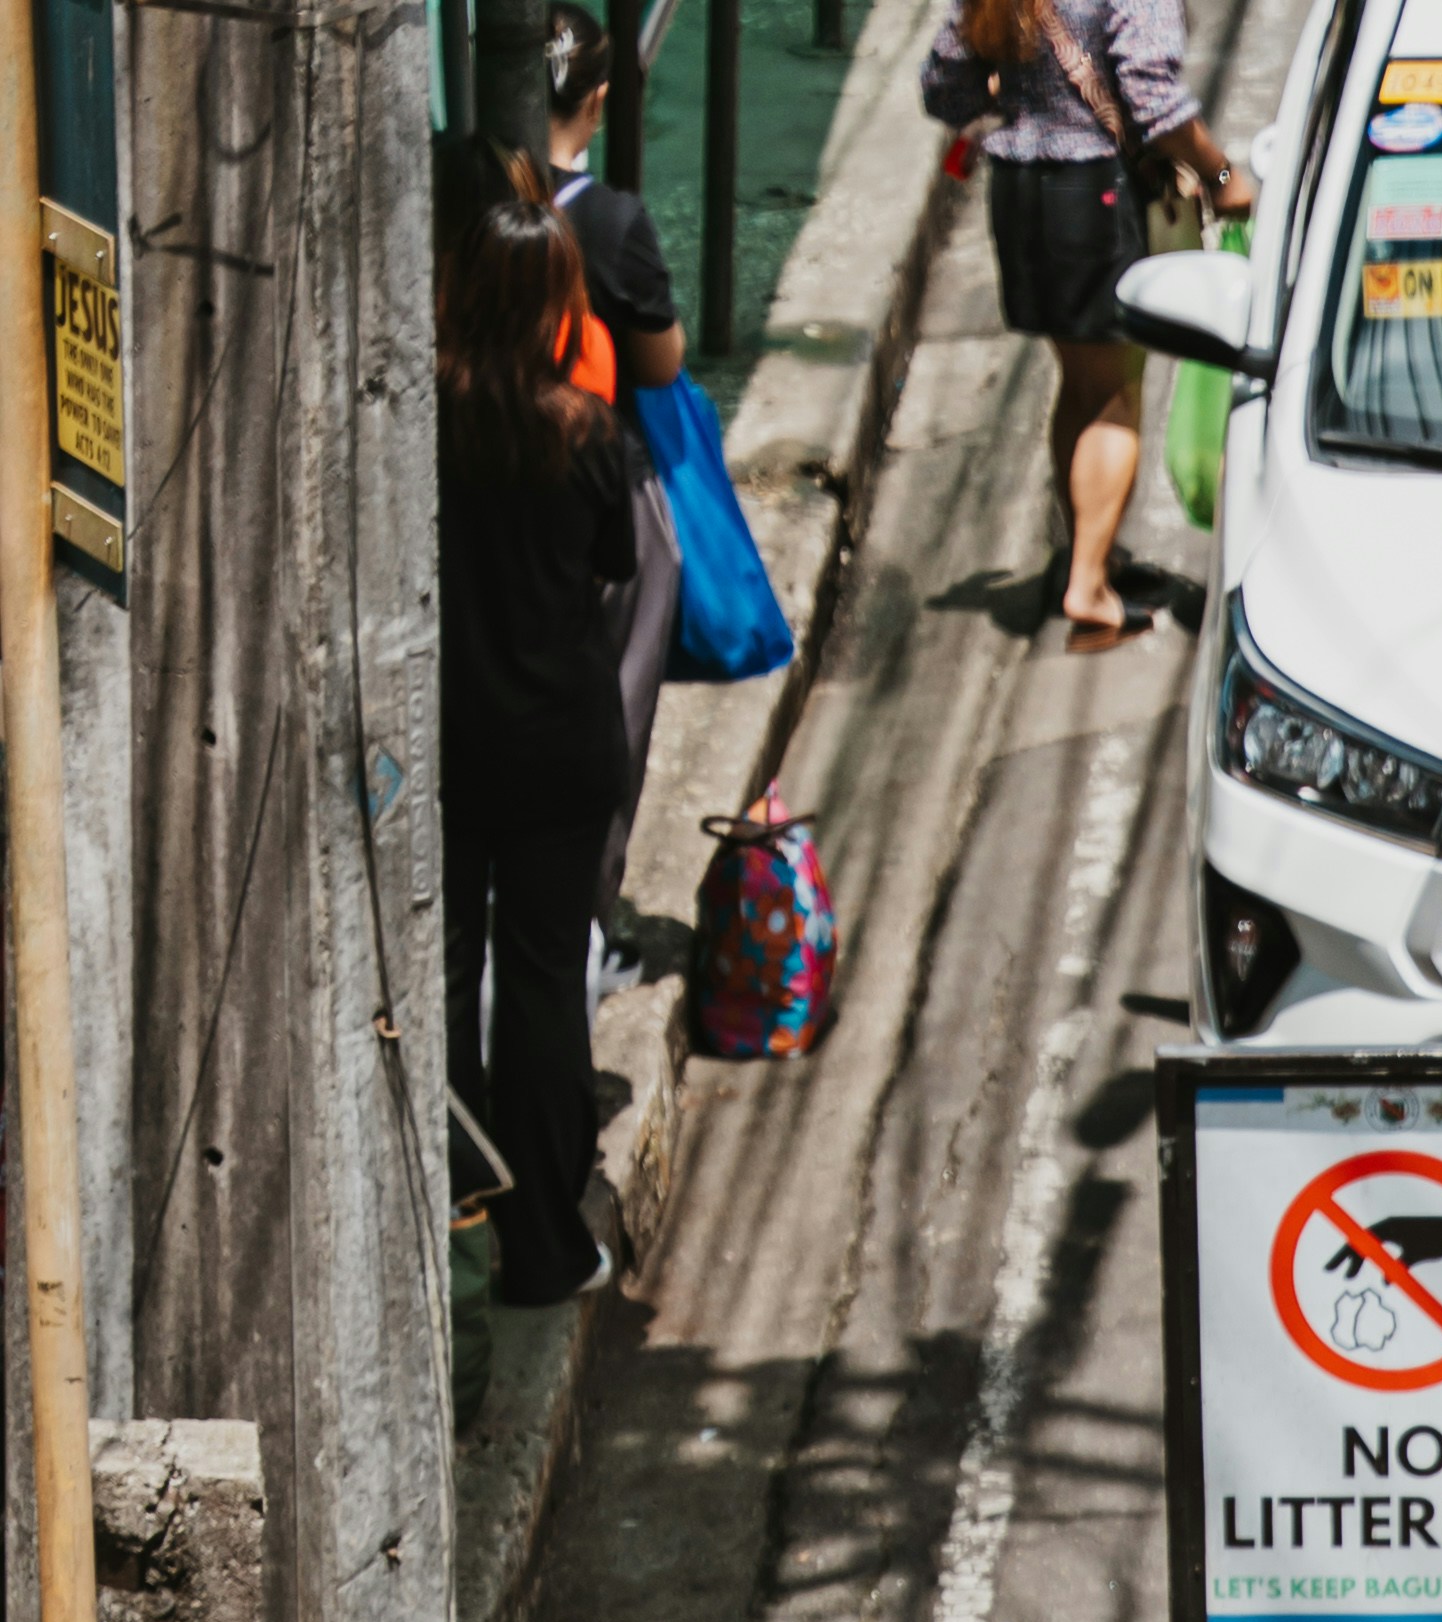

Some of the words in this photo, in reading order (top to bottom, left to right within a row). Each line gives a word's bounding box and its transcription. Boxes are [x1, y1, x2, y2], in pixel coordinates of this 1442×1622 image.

[1404, 268, 1434, 298] ON
[56, 265, 119, 361] JESUS
[1212, 1577, 1282, 1600] LET'S
[1289, 1577, 1356, 1599] KEEP
